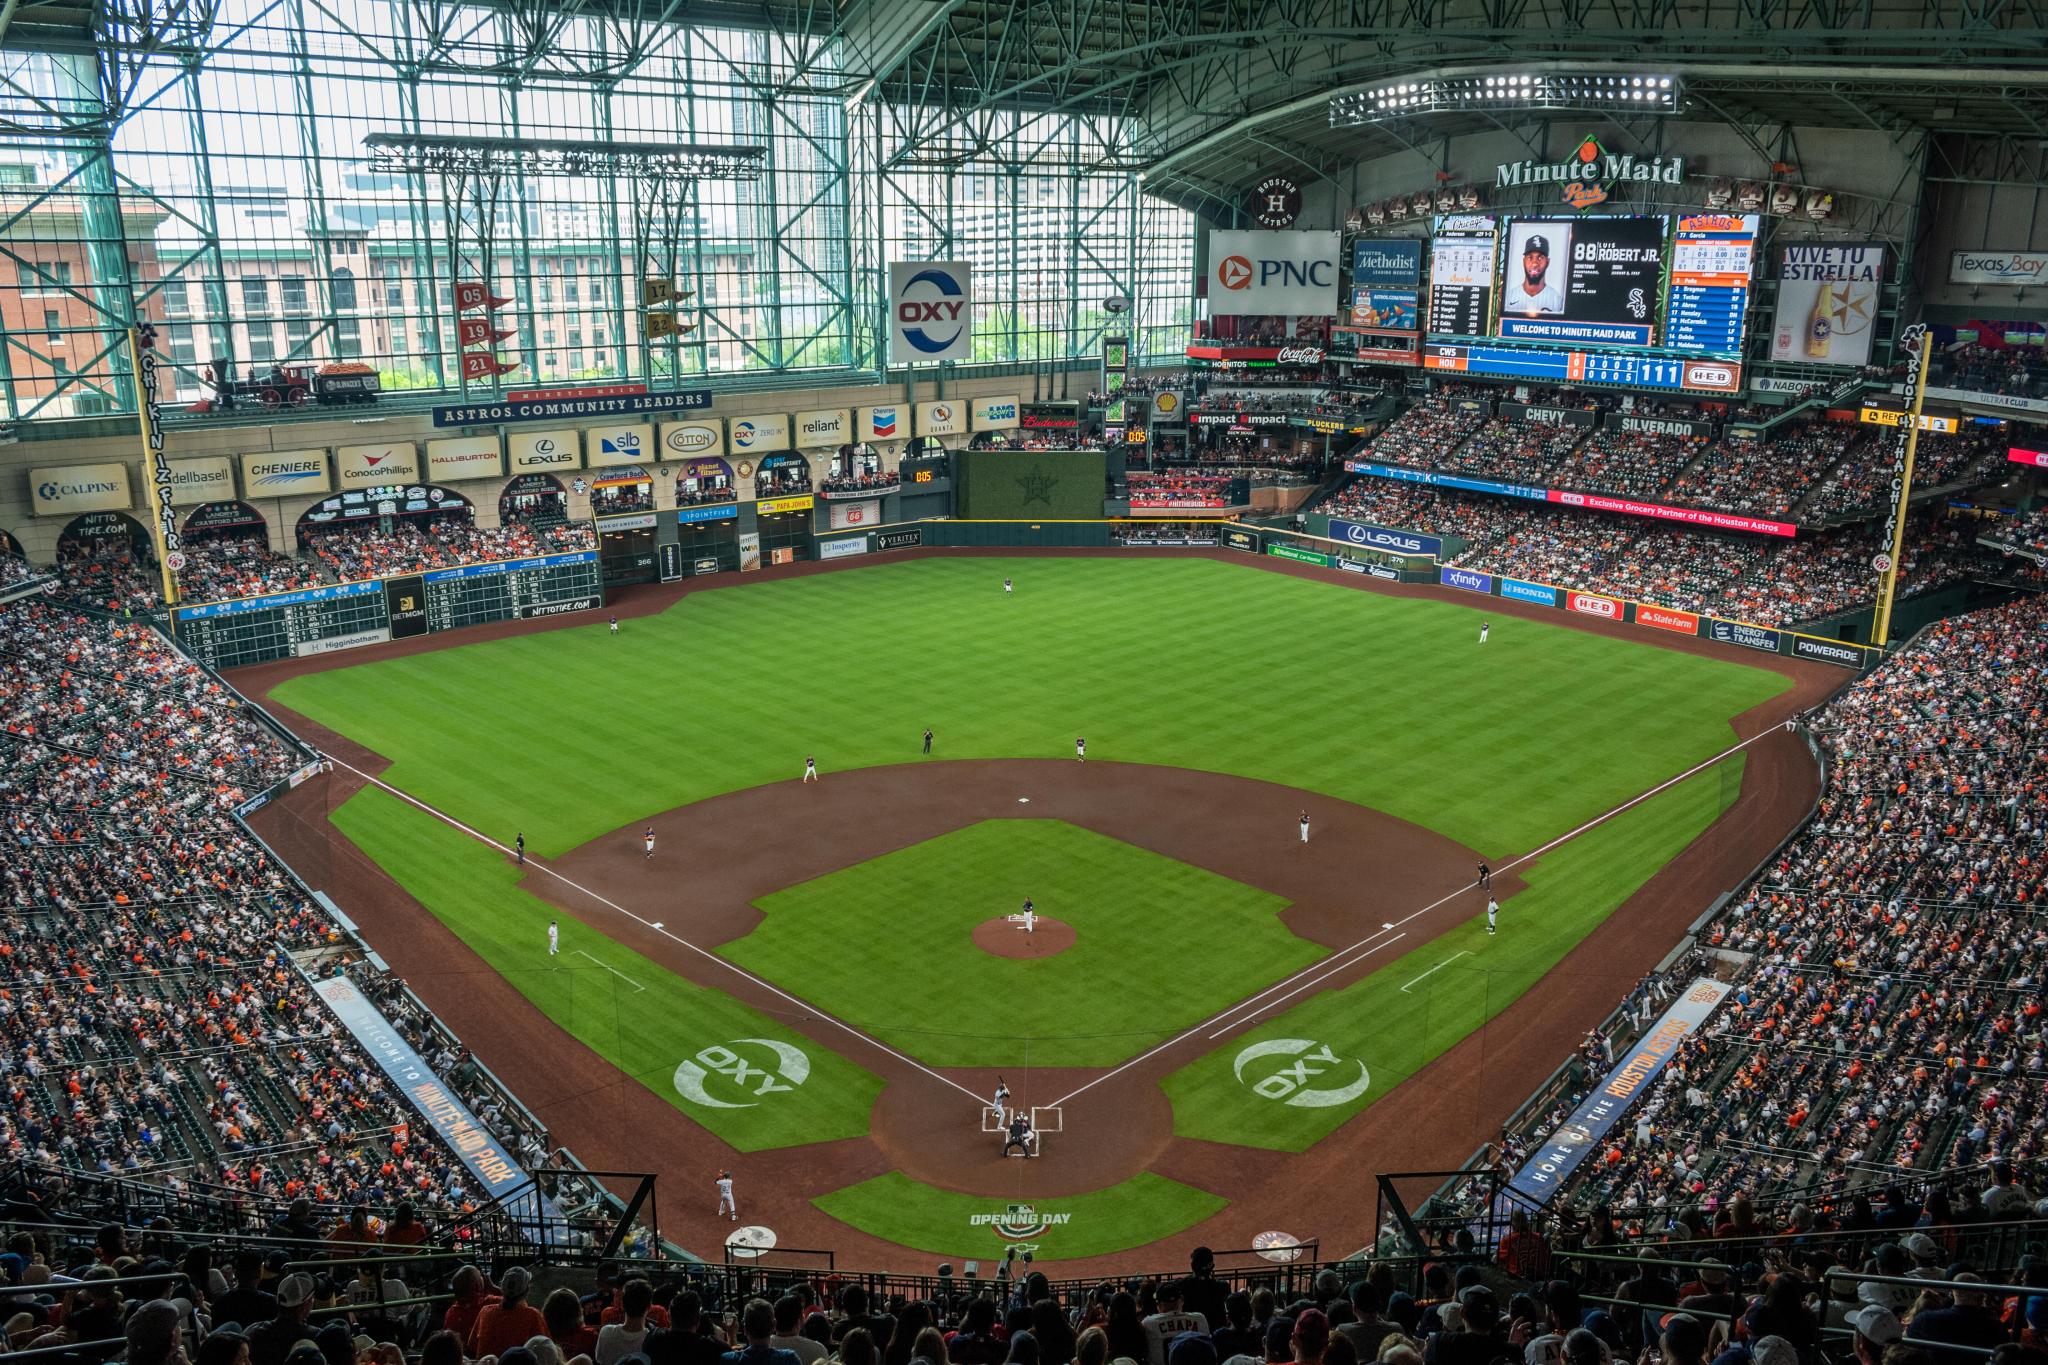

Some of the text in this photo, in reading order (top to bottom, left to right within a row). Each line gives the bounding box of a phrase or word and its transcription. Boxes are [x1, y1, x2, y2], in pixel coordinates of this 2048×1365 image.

[1496, 154, 1681, 187] Minute Maid
[1257, 178, 1297, 194] HOUSTON
[1563, 183, 1607, 202] Park
[1267, 195, 1285, 212] H
[1258, 213, 1293, 226] ASTROS
[1689, 214, 1733, 230] ASTROS
[1574, 243, 1597, 261] 88
[1598, 248, 1660, 262] ROBERT JR.
[1838, 247, 1866, 264] TU
[1359, 254, 1415, 269] Methodist
[1958, 253, 2047, 277] Texas Bay
[1257, 260, 1332, 287] PNC
[1780, 264, 1881, 282] ESTRELLA!
[463, 289, 482, 302] 05
[651, 285, 666, 298] 17
[898, 301, 965, 322] OXY
[467, 324, 485, 338] 19
[653, 319, 668, 331] 22
[1512, 324, 1637, 340] WELCOME TO MINUTE MAID PARK
[1440, 347, 1457, 357] CWS
[469, 357, 487, 371] 21
[1439, 358, 1455, 368] HOU
[522, 386, 636, 400] MINUTE MAID
[1773, 381, 1811, 391] NABOR
[520, 399, 627, 417] COMMUNITY
[633, 393, 704, 410] LEADERS
[2009, 399, 2029, 408] CLUB
[872, 407, 896, 415] Chevron
[989, 404, 1016, 420] LNG
[1525, 408, 1566, 423] CHEVY
[802, 419, 841, 433] reliant
[1022, 415, 1078, 428] Budweiser
[1199, 414, 1287, 425] impact impact
[1307, 419, 1345, 430] PLUCKERS
[1621, 417, 1692, 436] SILVERADO
[734, 431, 756, 439] OXY
[930, 425, 954, 433] QUANTA
[616, 432, 641, 448] slb
[673, 433, 711, 447] COTTON
[1128, 431, 1146, 442] 0:05
[140, 355, 164, 450] CHIKIN
[158, 486, 180, 551] FAIR
[431, 453, 498, 464] HALLIBURTON
[518, 453, 573, 466] LEXUS
[251, 460, 321, 475] CHENIERE
[697, 463, 719, 472] planet
[773, 460, 802, 468] SPORTSNET
[147, 468, 228, 485] dellbasell
[344, 465, 414, 479] ConocoPhillips
[599, 471, 628, 480] Crawford
[916, 471, 932, 482] 0:05
[1425, 472, 1433, 483] K
[60, 481, 120, 496] CALPINE
[85, 513, 118, 524] NITTO
[205, 511, 240, 519] LANDRY'S
[686, 508, 731, 519] 1POINTFIVE
[849, 511, 861, 521] 66
[1589, 498, 1779, 534] Exclusive Grocery Partner of the Houston Astros
[78, 522, 127, 537] TIRE.COM
[194, 518, 231, 527] CRAWFORD
[887, 534, 919, 543] VERITEX
[1366, 531, 1422, 551] LEXUS
[831, 540, 860, 552] Insperity
[637, 558, 651, 566] 366
[1391, 555, 1404, 564] 370
[1450, 572, 1482, 589] xfinity
[1512, 586, 1553, 600] HONDA
[532, 600, 590, 617] NITTOTIRE.COM
[154, 612, 170, 621] 315
[392, 611, 425, 621] BETMGM
[1733, 625, 1767, 638] ENERGY
[325, 634, 380, 648] Higginbotham
[1733, 633, 1775, 649] TRANSFER
[1798, 641, 1858, 661] POWERADE
[696, 1045, 794, 1097] OXY
[1252, 1044, 1343, 1100] OXY
[357, 1015, 517, 1185] WELCOME TO MINUTE MAID PARK
[1532, 1017, 1693, 1183] HOME OF THE HOUSTON ASTROS
[970, 1212, 1071, 1226] OPENING DAY
[1158, 1319, 1200, 1333] CHAPA
